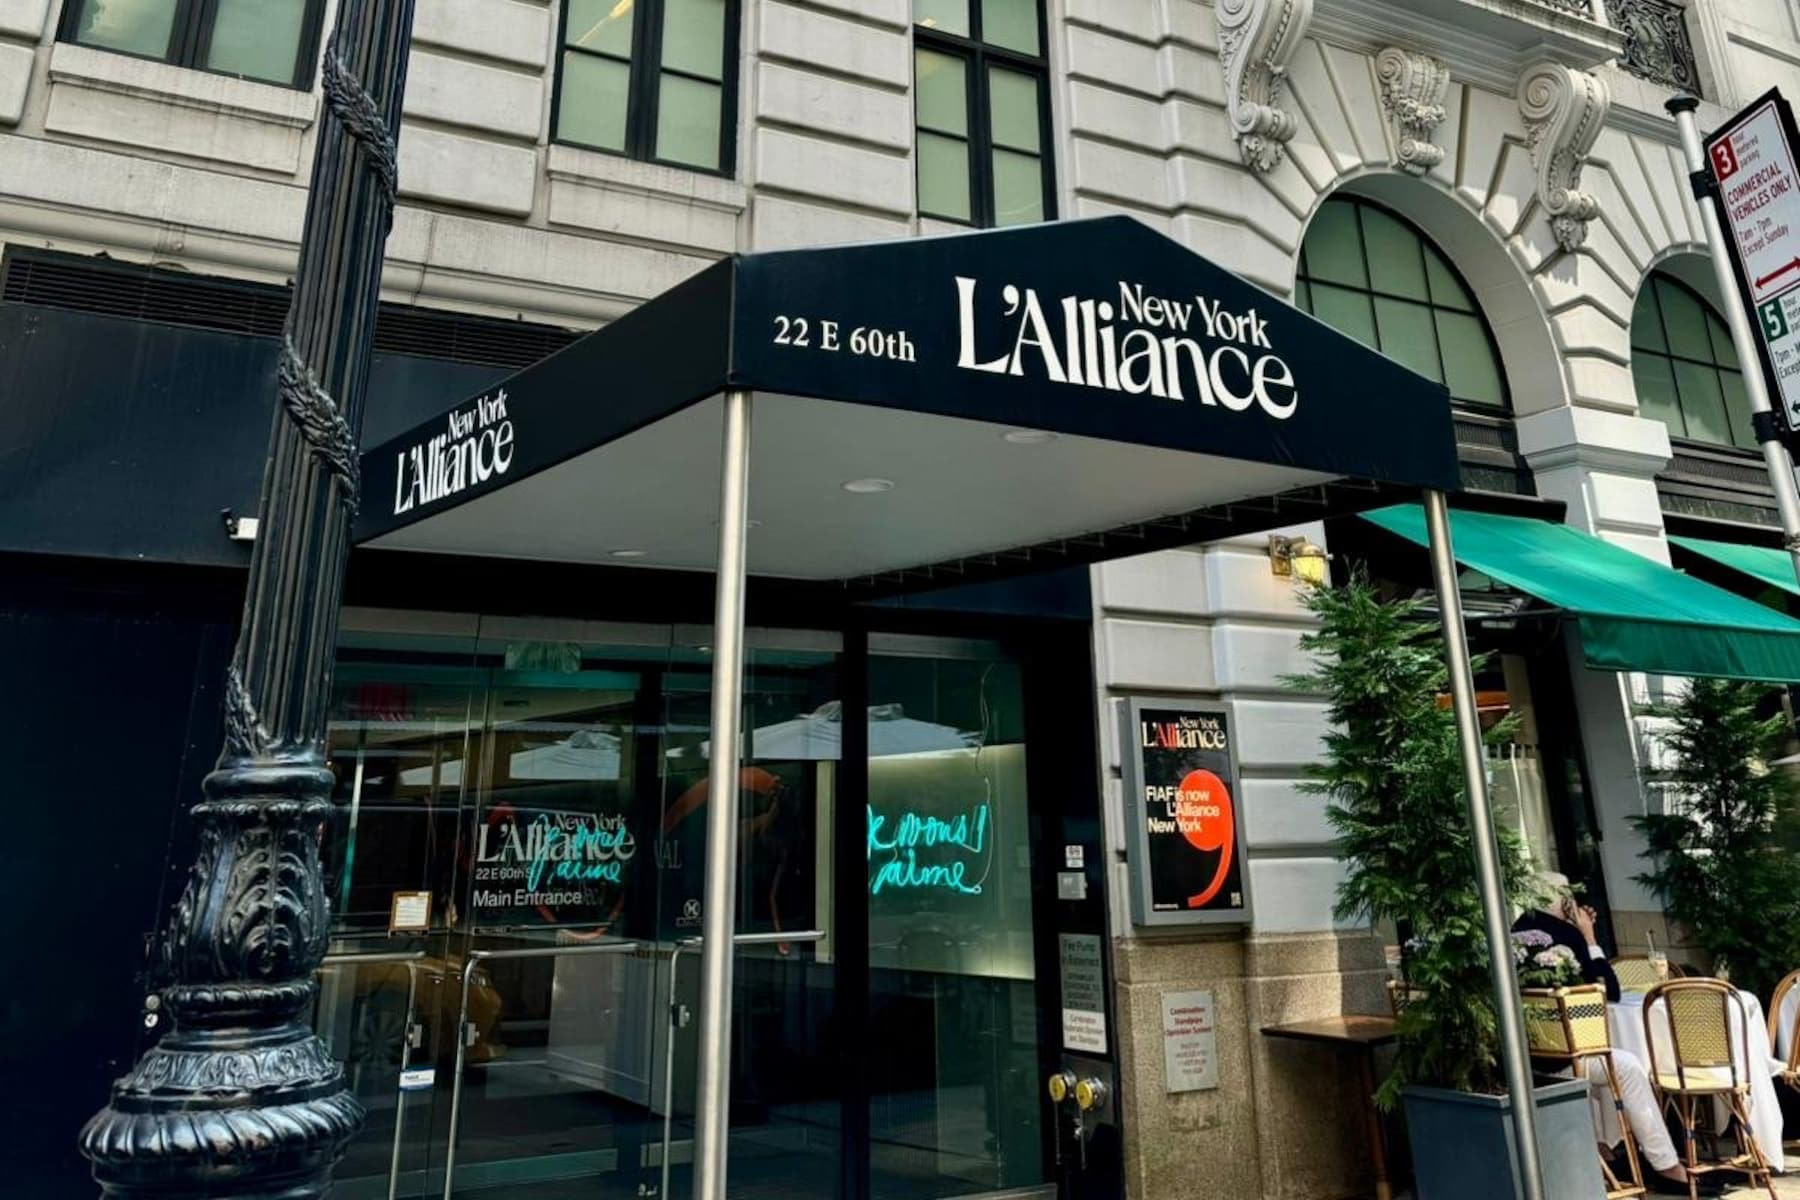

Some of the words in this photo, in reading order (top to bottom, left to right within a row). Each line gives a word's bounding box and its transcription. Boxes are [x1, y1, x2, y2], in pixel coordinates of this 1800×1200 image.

[1716, 144, 1732, 174] 3
[1727, 160, 1782, 205] COMMERCIAL
[1732, 188, 1770, 221] VEHICLES
[1770, 174, 1792, 198] ONLY
[1743, 236, 1766, 257] Except
[1764, 223, 1789, 245] Sunday
[1118, 280, 1193, 327] New
[1196, 295, 1273, 350] York
[1764, 302, 1781, 338] 5
[772, 314, 810, 347] 22
[820, 322, 841, 352] E
[849, 326, 918, 364] 60th
[954, 275, 1299, 421] L'Alliance
[1779, 360, 1800, 379] Excep
[447, 409, 478, 444] New
[477, 387, 508, 429] York
[393, 420, 515, 516] L'Alliance
[1141, 721, 1227, 749] L'Alliance
[1179, 716, 1199, 730] New
[1200, 717, 1220, 730] York
[1145, 785, 1175, 802] FIAF
[1175, 786, 1185, 802] is
[1185, 790, 1211, 802] now
[1166, 801, 1220, 818] L'Alliance
[554, 812, 590, 831] New
[591, 812, 627, 831] York
[1147, 817, 1176, 834] New
[1178, 817, 1202, 833] York
[476, 816, 637, 862] L'Alliance
[475, 868, 490, 880] 22
[491, 867, 498, 880] E
[499, 866, 525, 880] 60th
[472, 889, 512, 908] Main
[513, 887, 583, 907] Entrance
